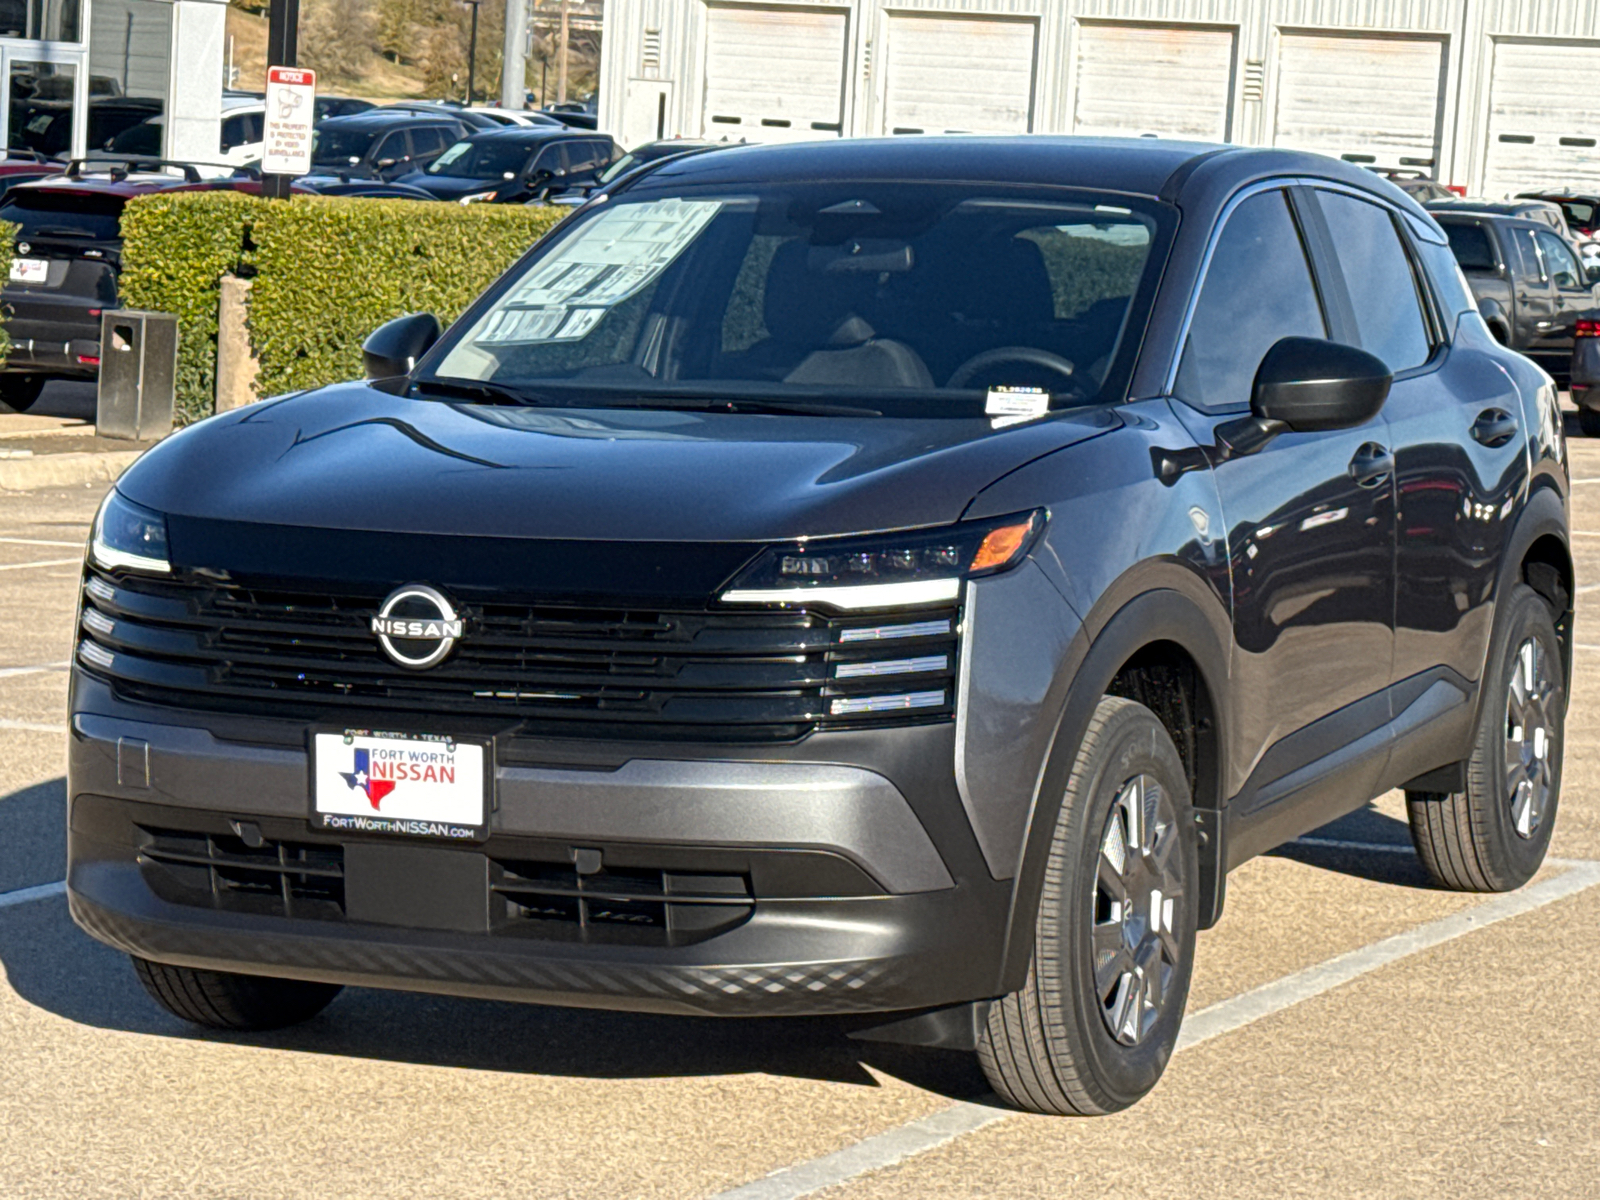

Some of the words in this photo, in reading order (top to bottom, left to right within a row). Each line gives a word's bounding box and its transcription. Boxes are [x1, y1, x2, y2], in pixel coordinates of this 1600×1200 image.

[279, 71, 304, 83] NOTICE
[372, 618, 459, 637] NISSAN
[344, 728, 369, 737] FORT
[373, 730, 407, 739] WORTH
[421, 733, 453, 743] TEXAS
[372, 748, 405, 761] FORT
[408, 750, 455, 764] WORTH
[372, 761, 455, 784] NISSAN
